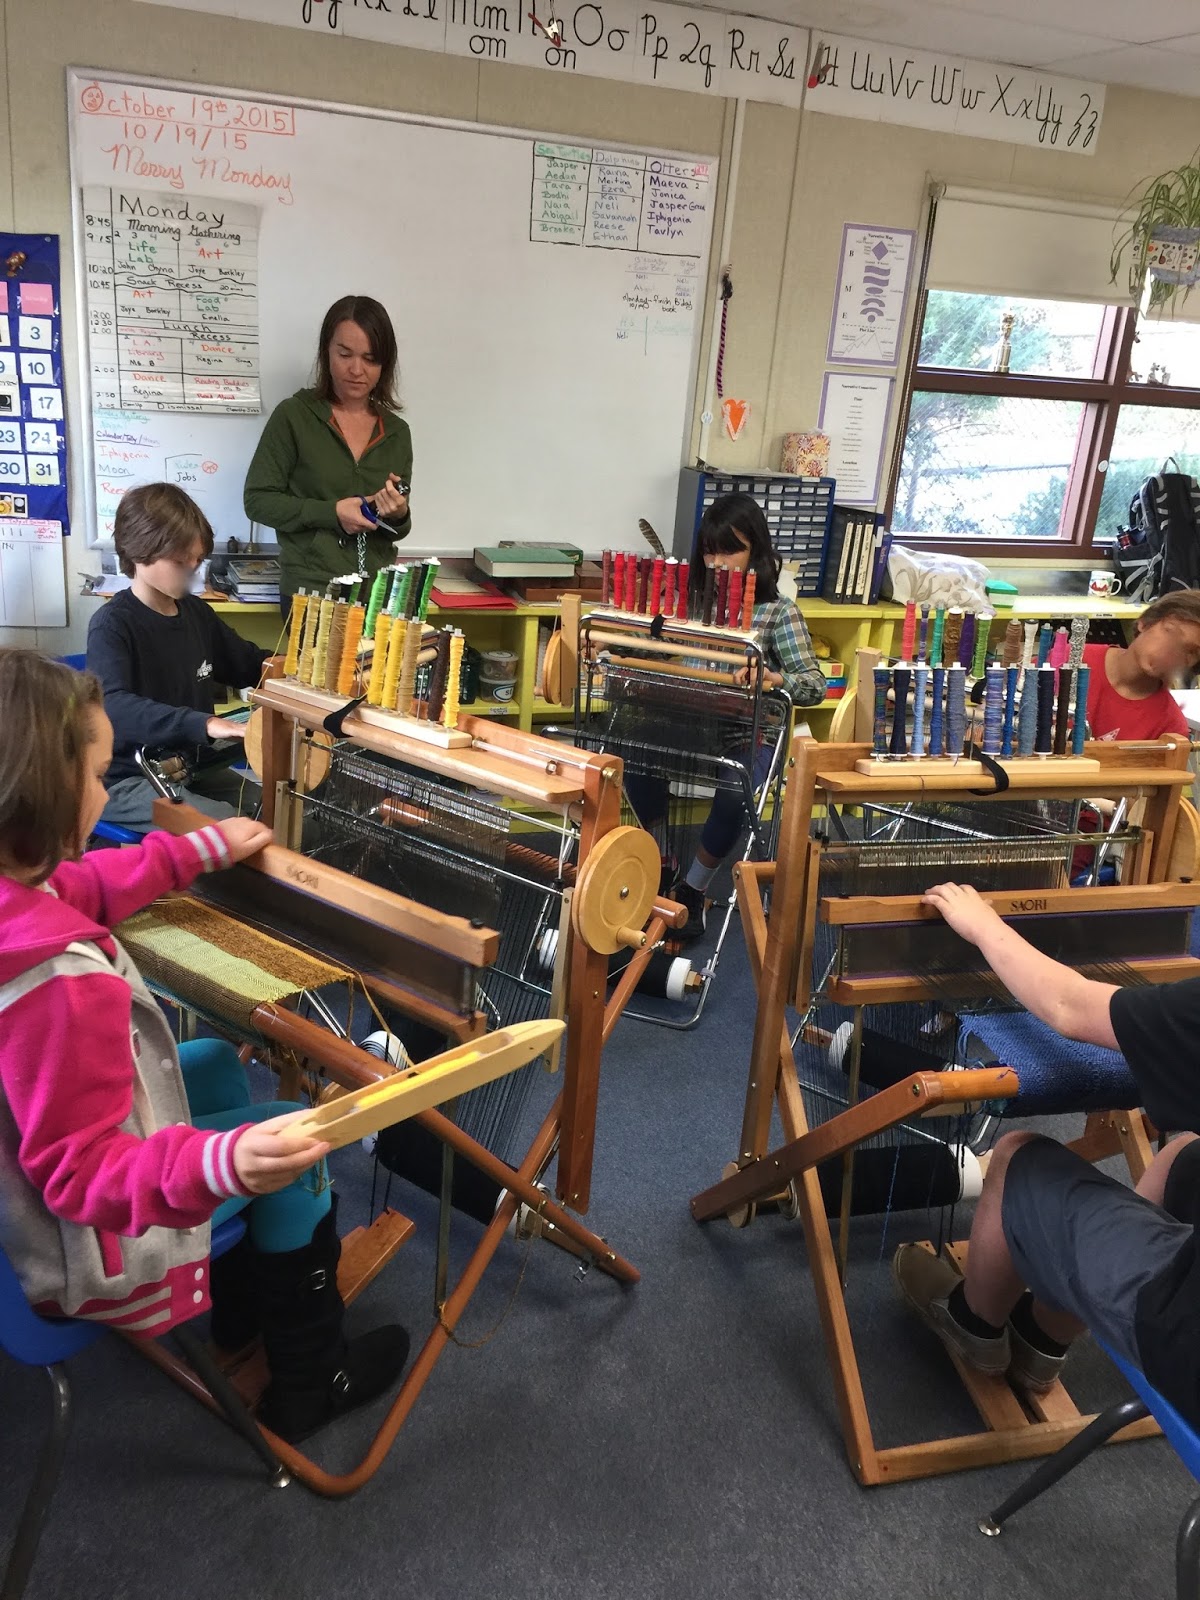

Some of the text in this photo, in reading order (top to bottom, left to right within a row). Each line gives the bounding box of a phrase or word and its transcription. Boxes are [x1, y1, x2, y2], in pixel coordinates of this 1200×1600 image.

[469, 35, 507, 59] om
[545, 47, 577, 69] on
[232, 104, 289, 132] 2015
[123, 121, 249, 151] 10/19/15
[101, 144, 184, 189] Merry
[119, 194, 225, 229] Monday
[127, 219, 181, 242] Morning
[128, 240, 225, 260] Life Art
[128, 252, 154, 264] Lab
[126, 276, 157, 286] Snack
[132, 289, 155, 299] Art
[30, 326, 41, 340] 3
[162, 319, 213, 333] Lunch
[201, 343, 235, 354] Dance
[28, 362, 45, 375] 10
[38, 396, 54, 410] 17
[35, 463, 52, 476] 31
[174, 471, 198, 483] Jobs
[1010, 899, 1048, 912] SAORI
